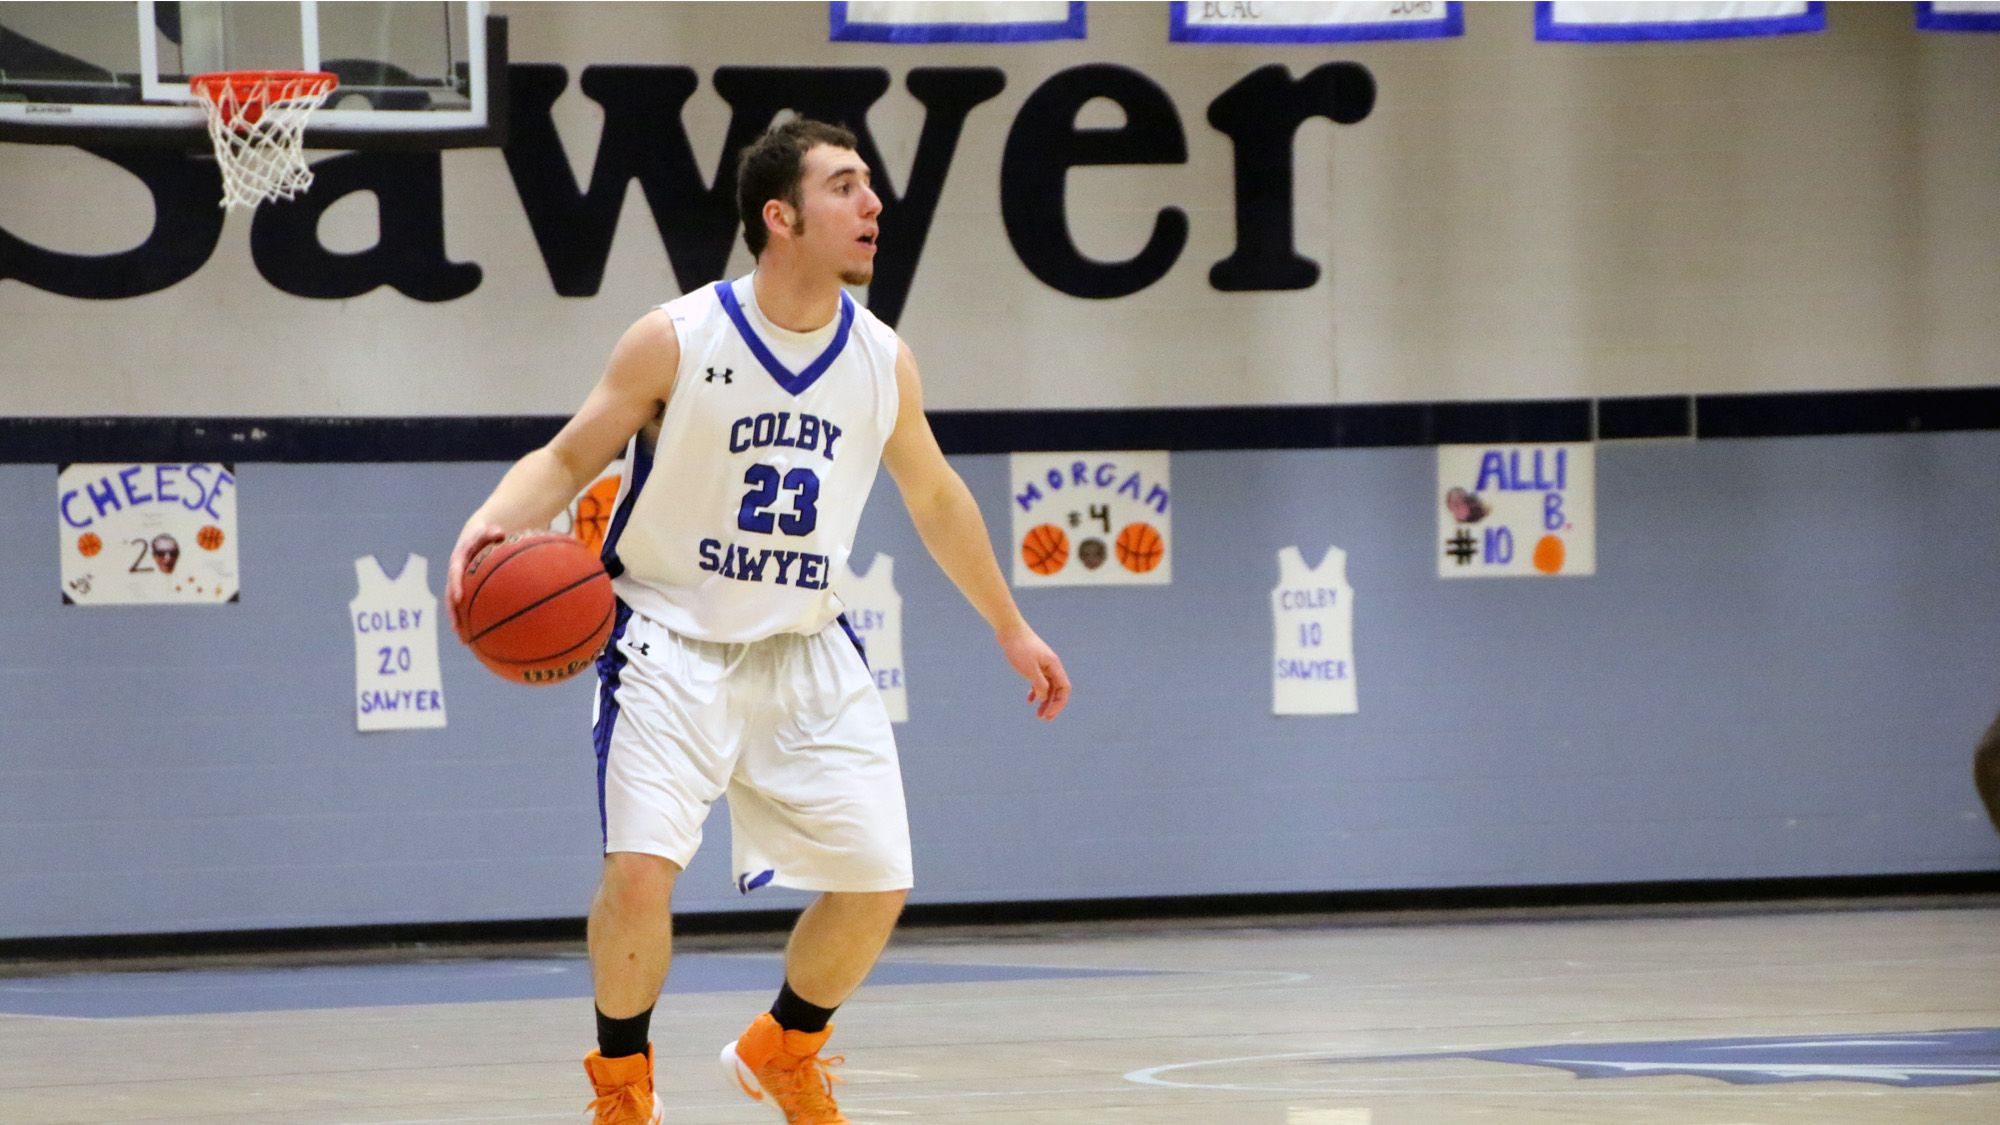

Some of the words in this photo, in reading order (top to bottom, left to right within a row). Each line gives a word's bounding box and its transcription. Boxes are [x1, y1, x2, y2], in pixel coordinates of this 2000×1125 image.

[729, 412, 842, 460] COLBY
[1475, 449, 1567, 491] ALLI
[61, 463, 234, 528] CHEESE
[738, 463, 820, 537] 23
[699, 538, 829, 590] SAWYE
[1281, 587, 1337, 611] COLBY
[357, 608, 422, 633] COLBY
[1300, 621, 1322, 648] 10
[378, 645, 411, 676] 20
[1278, 659, 1348, 680] SAWYER
[360, 689, 441, 713] SAWYER
